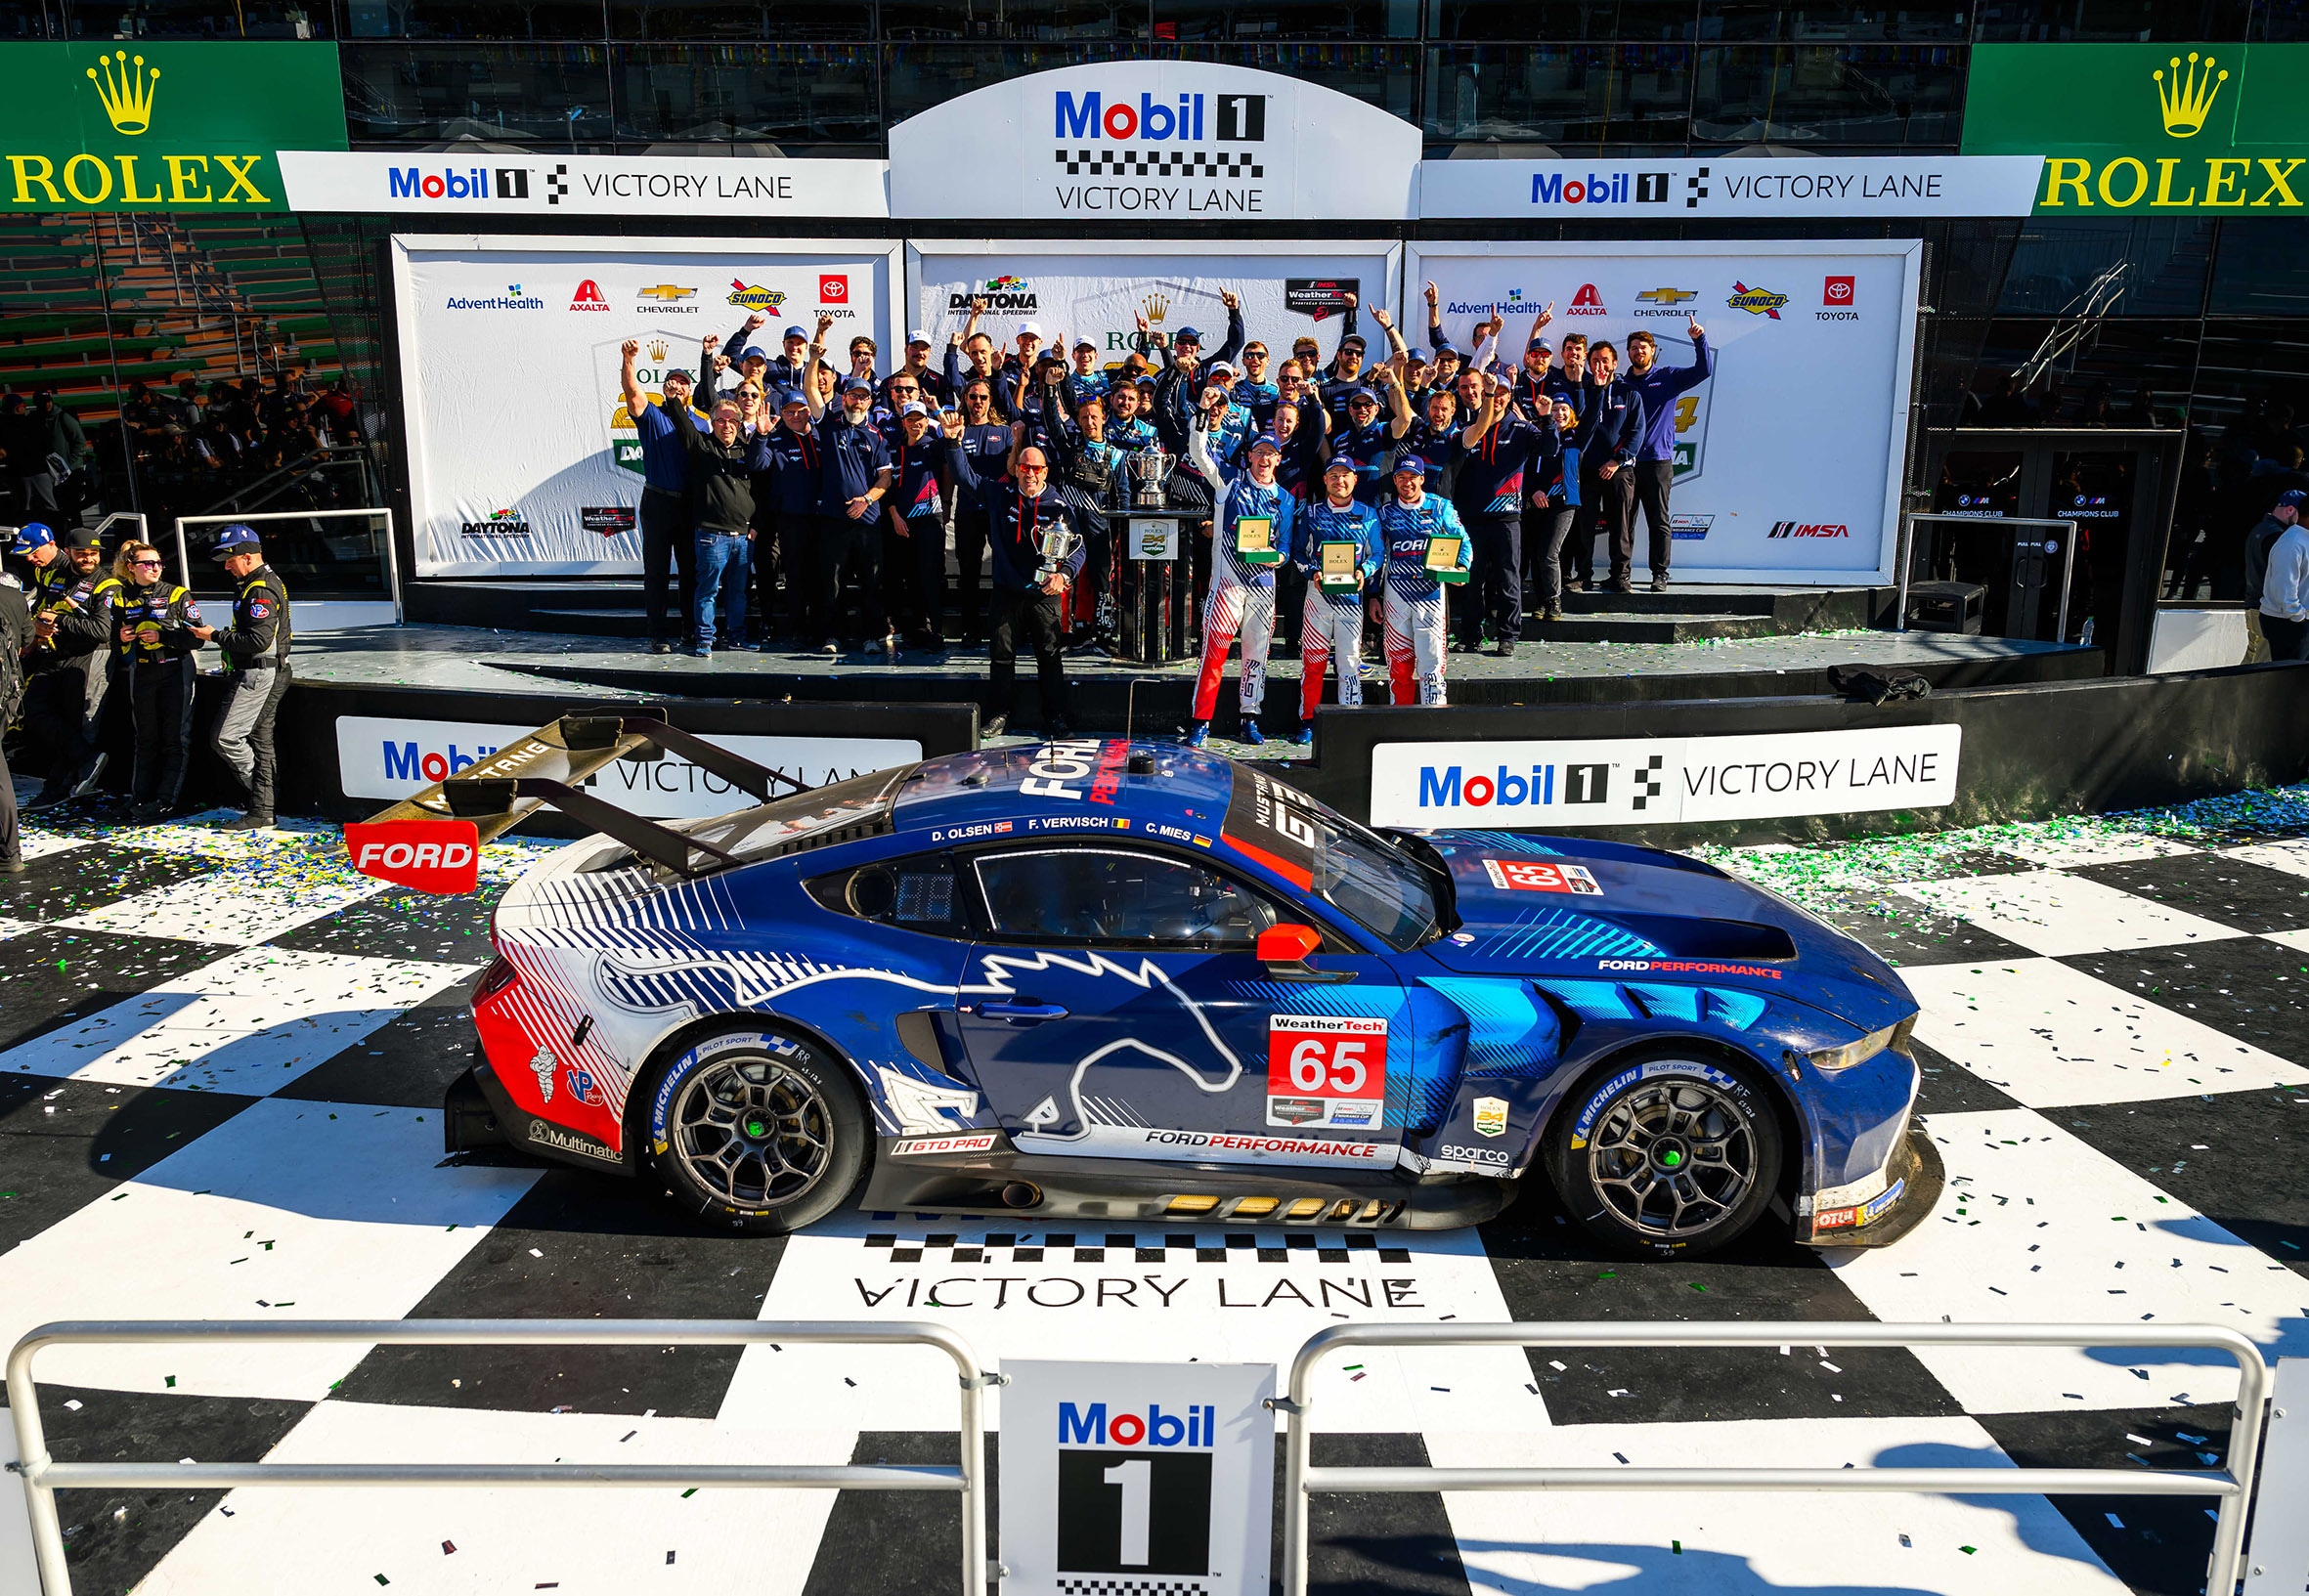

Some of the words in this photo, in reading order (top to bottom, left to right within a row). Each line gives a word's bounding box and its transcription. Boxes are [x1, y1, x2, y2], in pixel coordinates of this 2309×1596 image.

[1055, 91, 1204, 141] Mobil
[5, 152, 271, 205] ROLEX
[389, 167, 489, 199] Mobil
[583, 173, 709, 198] VICTORY
[717, 175, 793, 199] LANE
[2039, 156, 2306, 207] ROLEX
[1531, 173, 1629, 204] Mobil
[1724, 174, 1854, 200] VICTORY
[1861, 173, 1942, 198] LANE
[1055, 186, 1179, 211] VICTORY
[1188, 188, 1263, 212] LANE
[446, 295, 545, 311] AdventHealth
[731, 293, 782, 304] SUNOCO
[1288, 290, 1345, 299] WeatherTe
[1731, 296, 1784, 307] SUNOCO
[568, 303, 611, 313] AXALTA
[1566, 308, 1608, 317] AXALTA
[1634, 309, 1698, 318] CHEVROLET
[1814, 312, 1859, 321] TOYOTA
[461, 522, 530, 534] DAYTONA
[1793, 524, 1850, 538] IMSA
[1392, 538, 1428, 552] FOR
[382, 740, 498, 782] Mob
[423, 742, 551, 810] MTANG
[1418, 764, 1555, 807] Mobil
[1681, 758, 1840, 798] VICTORY
[1849, 753, 1939, 786] LANE
[931, 830, 945, 841] D.
[947, 824, 992, 840] OLSEN
[1038, 817, 1109, 830] VERVISCH
[1145, 822, 1157, 834] C.
[1159, 826, 1192, 841] MIES
[357, 842, 473, 869] FORD
[1505, 864, 1562, 886] 65
[1275, 1017, 1383, 1032] WeatherTech
[702, 1040, 723, 1054] PILOT
[725, 1036, 754, 1046] SPORT
[795, 1049, 811, 1065] RR
[1288, 1039, 1368, 1093] 65
[1648, 1063, 1670, 1072] PILOT
[1672, 1063, 1698, 1072] SPORT
[567, 1069, 593, 1102] VP
[654, 1055, 693, 1126] MICHELIN
[1733, 1085, 1751, 1099] RF
[1585, 1069, 1637, 1126] MICHELIN
[1476, 1110, 1504, 1122] 24
[549, 1131, 623, 1161] Multimatic
[912, 1140, 951, 1152] GTD
[952, 1138, 991, 1149] PRO
[1440, 1144, 1509, 1163] sparco
[854, 1276, 1190, 1309] VICTORY
[1218, 1277, 1426, 1309] LANE
[1058, 1402, 1215, 1447] Mobil
